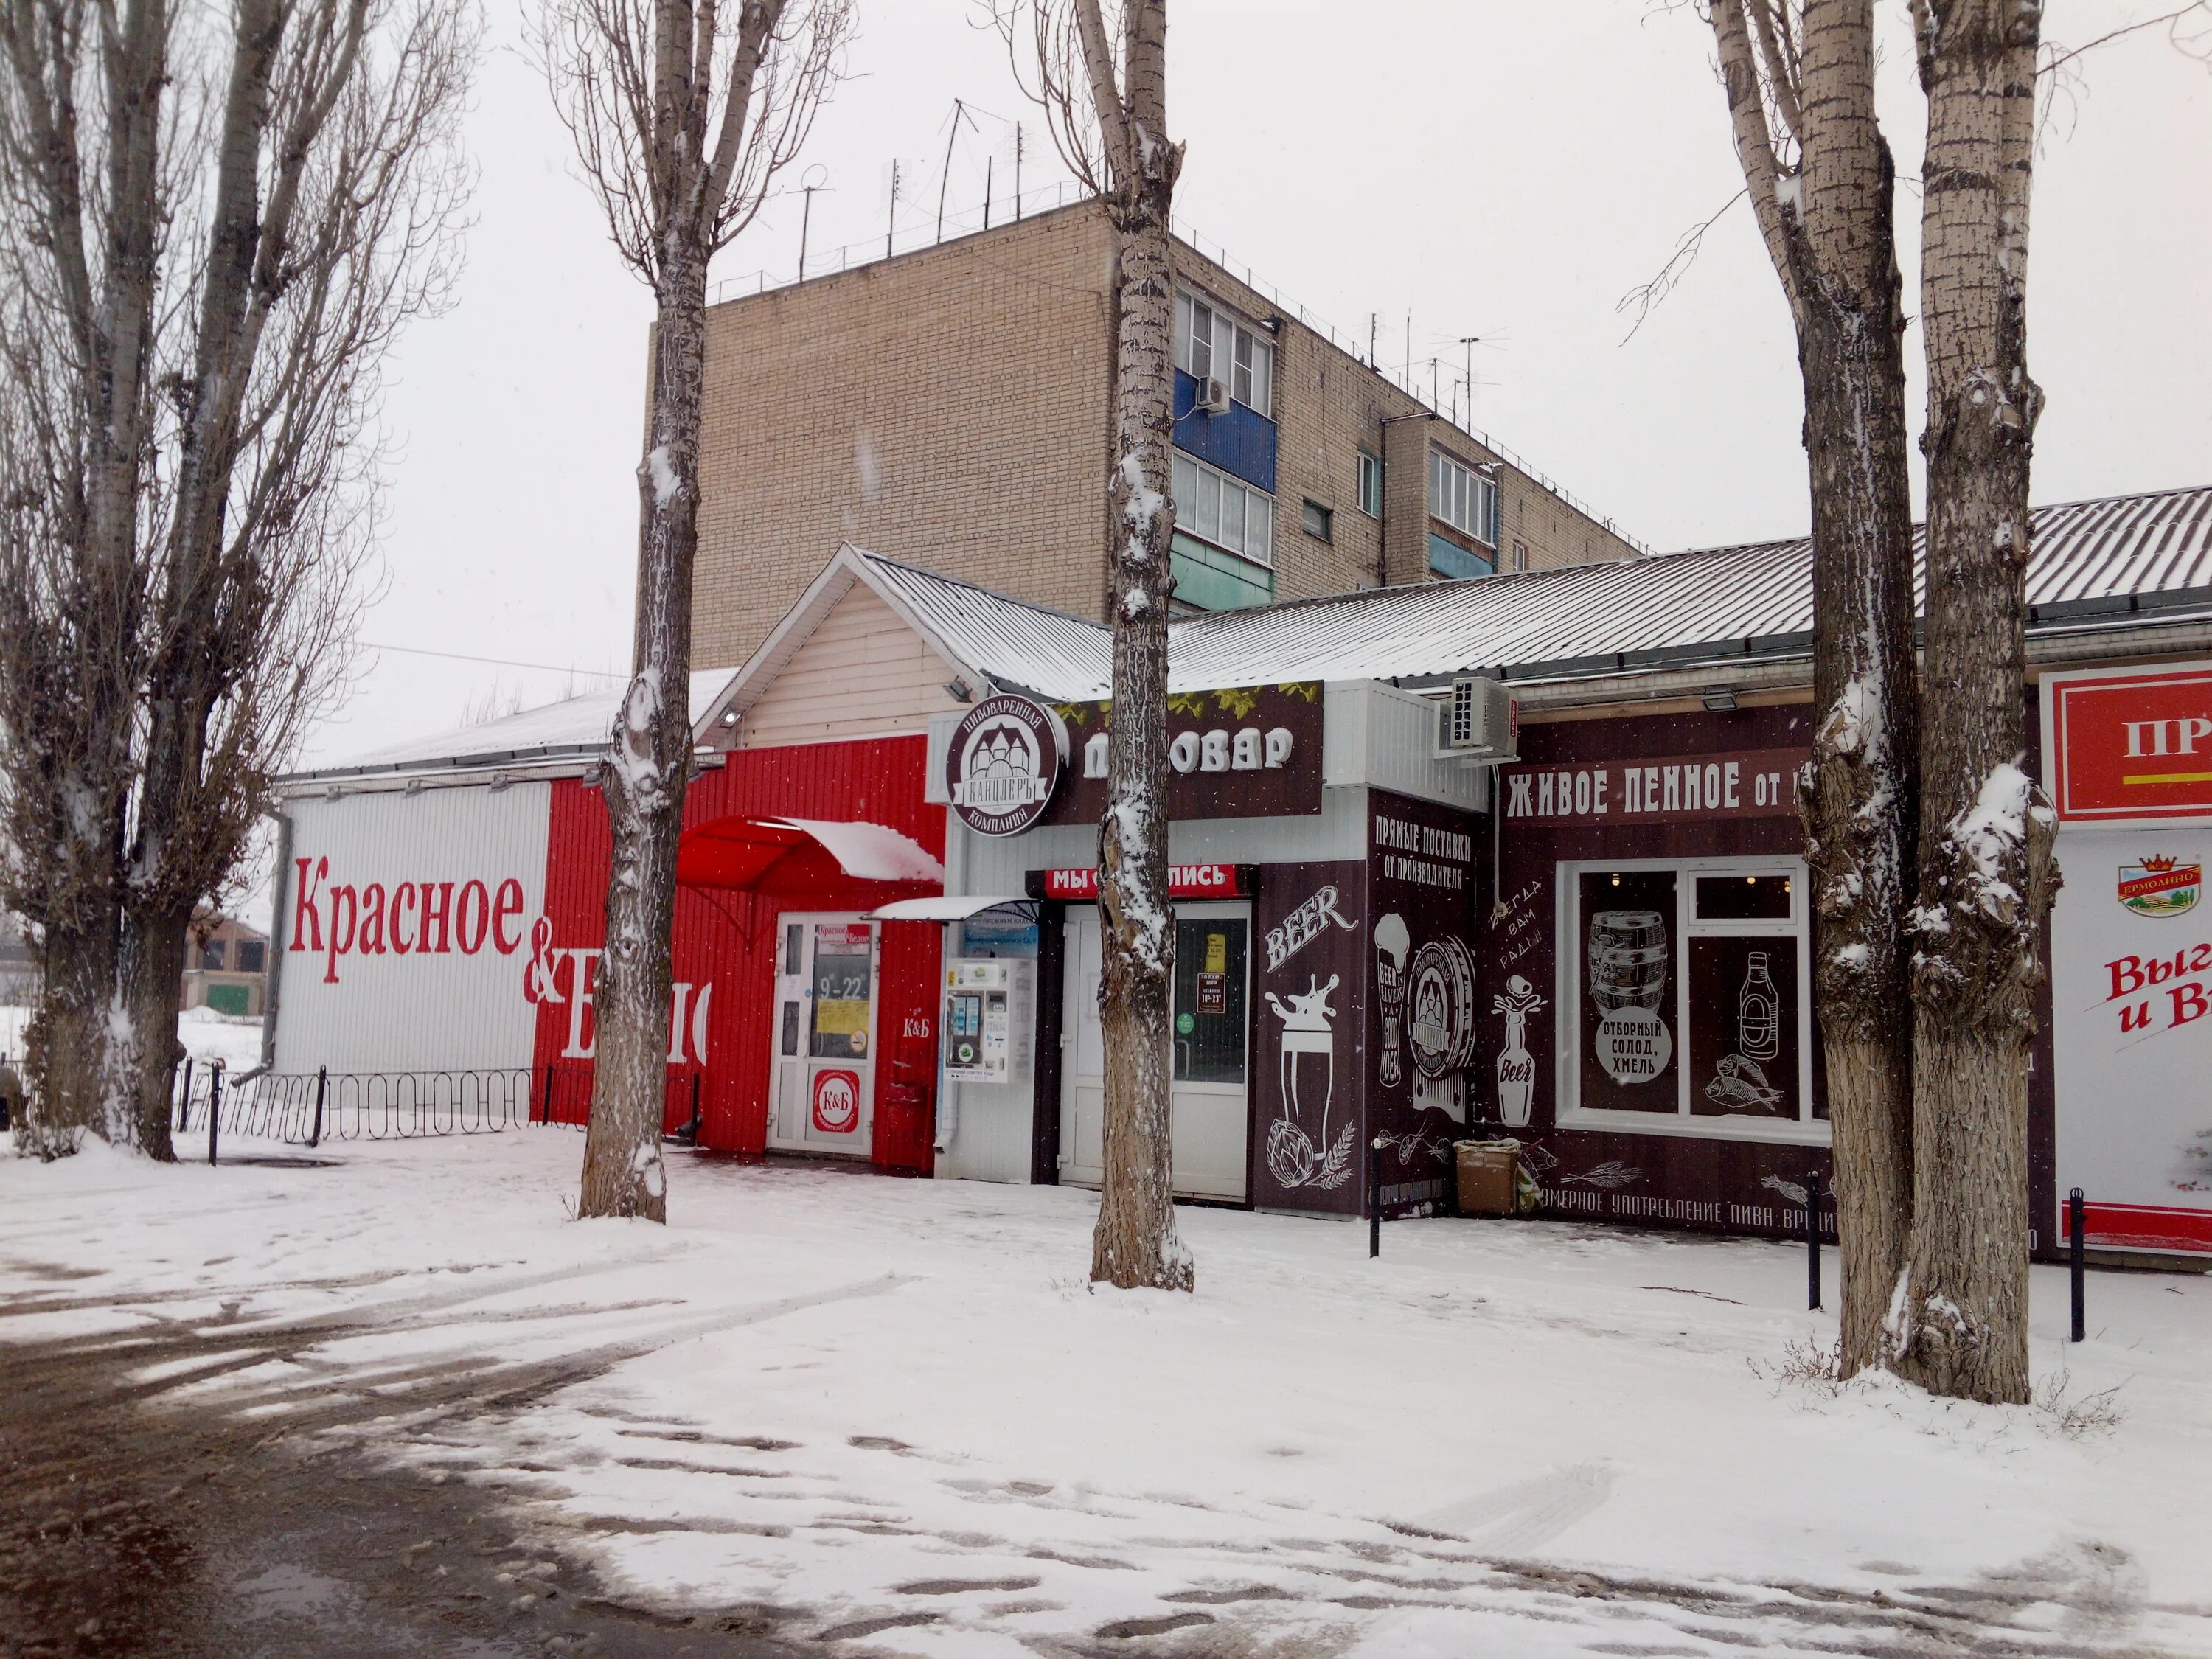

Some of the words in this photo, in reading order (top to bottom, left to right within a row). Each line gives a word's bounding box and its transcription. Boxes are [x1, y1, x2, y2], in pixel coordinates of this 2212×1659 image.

[963, 700, 1043, 734] ПИВОВАРЕННАЯ
[1083, 727, 1294, 779] ПОВАР
[969, 778, 1032, 804] КАНЦЛЕРЪ
[1507, 770, 1608, 817] ЖИВОЕ
[1624, 762, 1740, 813] ПЕННОЕ
[968, 808, 1029, 832] КОМПАНИЯ
[1375, 815, 1419, 852] ПРЯМЫЕ
[1423, 826, 1471, 863] ПОСТАВКИ
[1053, 870, 1088, 888] МЫ
[1385, 855, 1395, 879] ОТ
[1397, 857, 1463, 890] ПРОИЗВОДИТЕЛЯ
[2124, 872, 2194, 895] ЕРМОЛИНО
[289, 855, 524, 984] Красное
[1265, 885, 1359, 974] BEER
[1509, 908, 1536, 935] ВАМ
[1380, 961, 1397, 987] BEER
[2118, 1001, 2152, 1033] и
[2166, 982, 2212, 1029] В
[902, 1018, 930, 1038] К&Б
[1603, 1020, 1662, 1037] ОТБОРНЫЙ
[1612, 1038, 1658, 1057] СОЛОД,
[1382, 1050, 1399, 1082] IDEA
[1500, 1058, 1533, 1083] Beer
[1613, 1057, 1655, 1074] ХМЕЛЬ
[823, 1091, 849, 1111] К&Б
[1612, 1194, 1722, 1223] УПОТРЕБЛЕНИЕ
[1731, 1203, 1773, 1228] ПИВА
